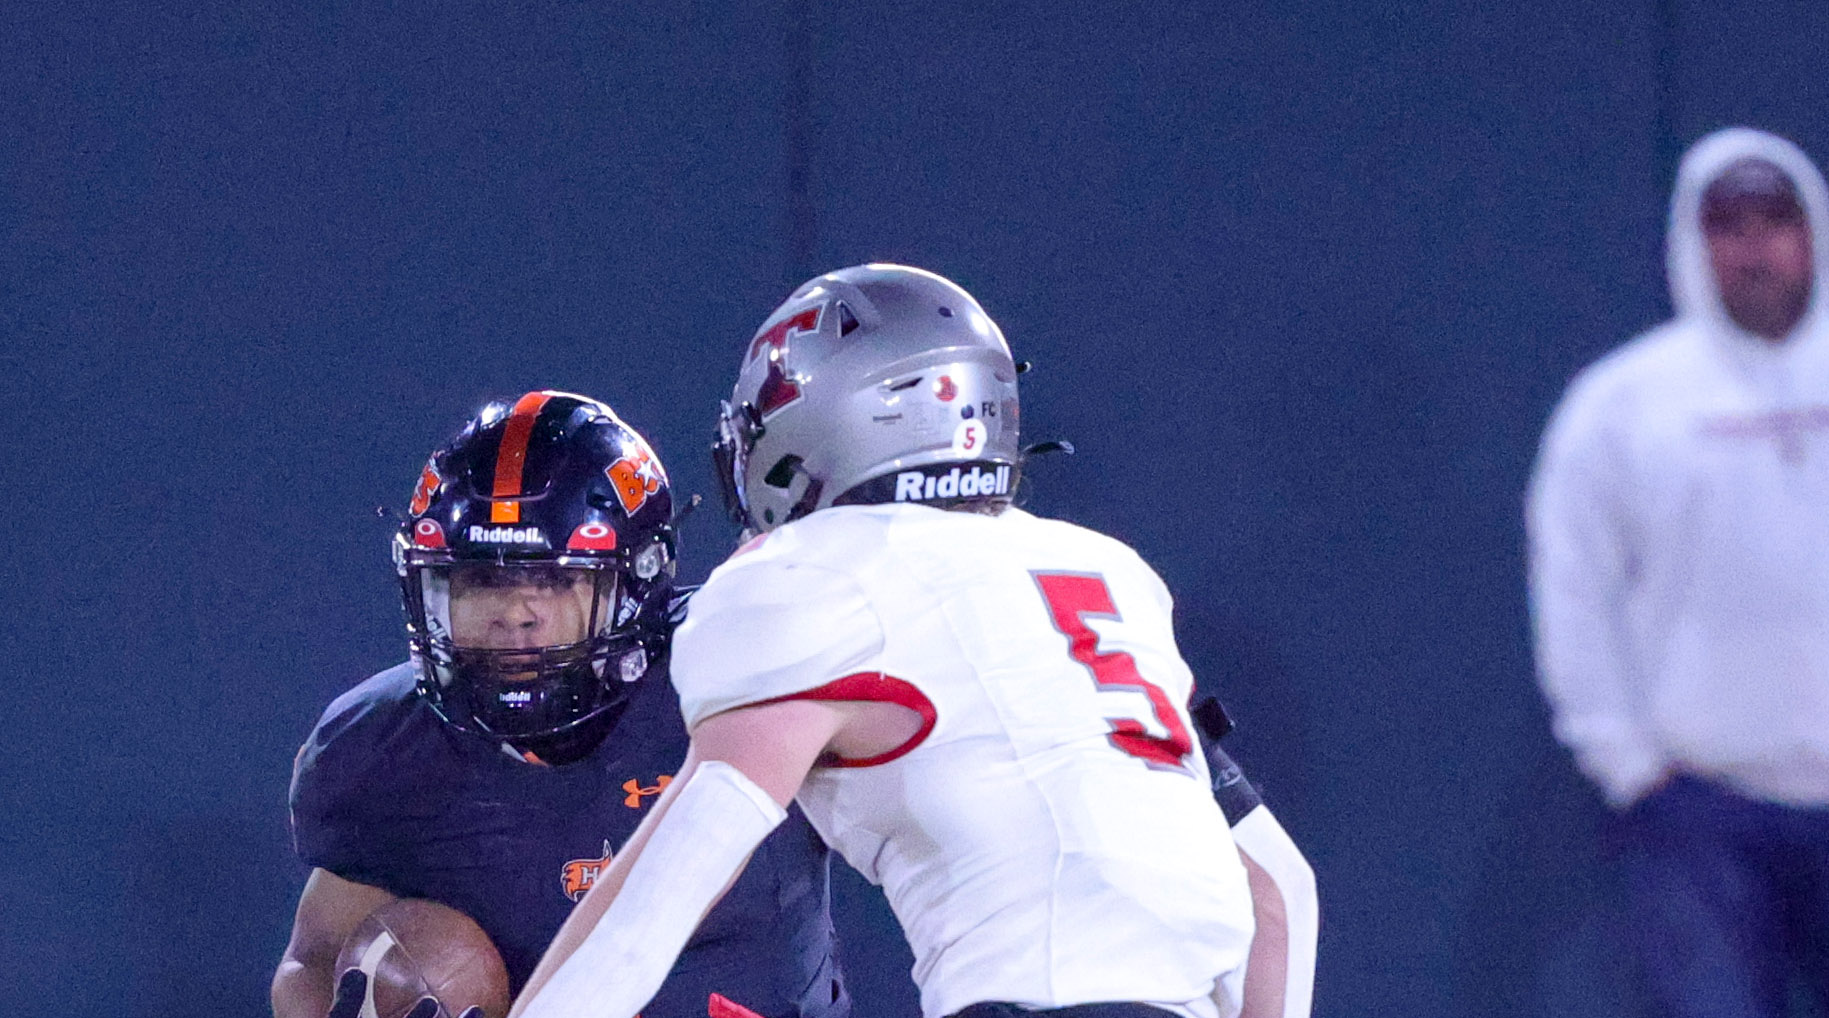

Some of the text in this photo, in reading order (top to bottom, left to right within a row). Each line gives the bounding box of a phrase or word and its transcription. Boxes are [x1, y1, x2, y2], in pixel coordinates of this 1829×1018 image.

[963, 427, 976, 451] 5
[895, 465, 1010, 501] Riddell
[469, 525, 544, 543] Riddell
[1027, 569, 1196, 780] 5
